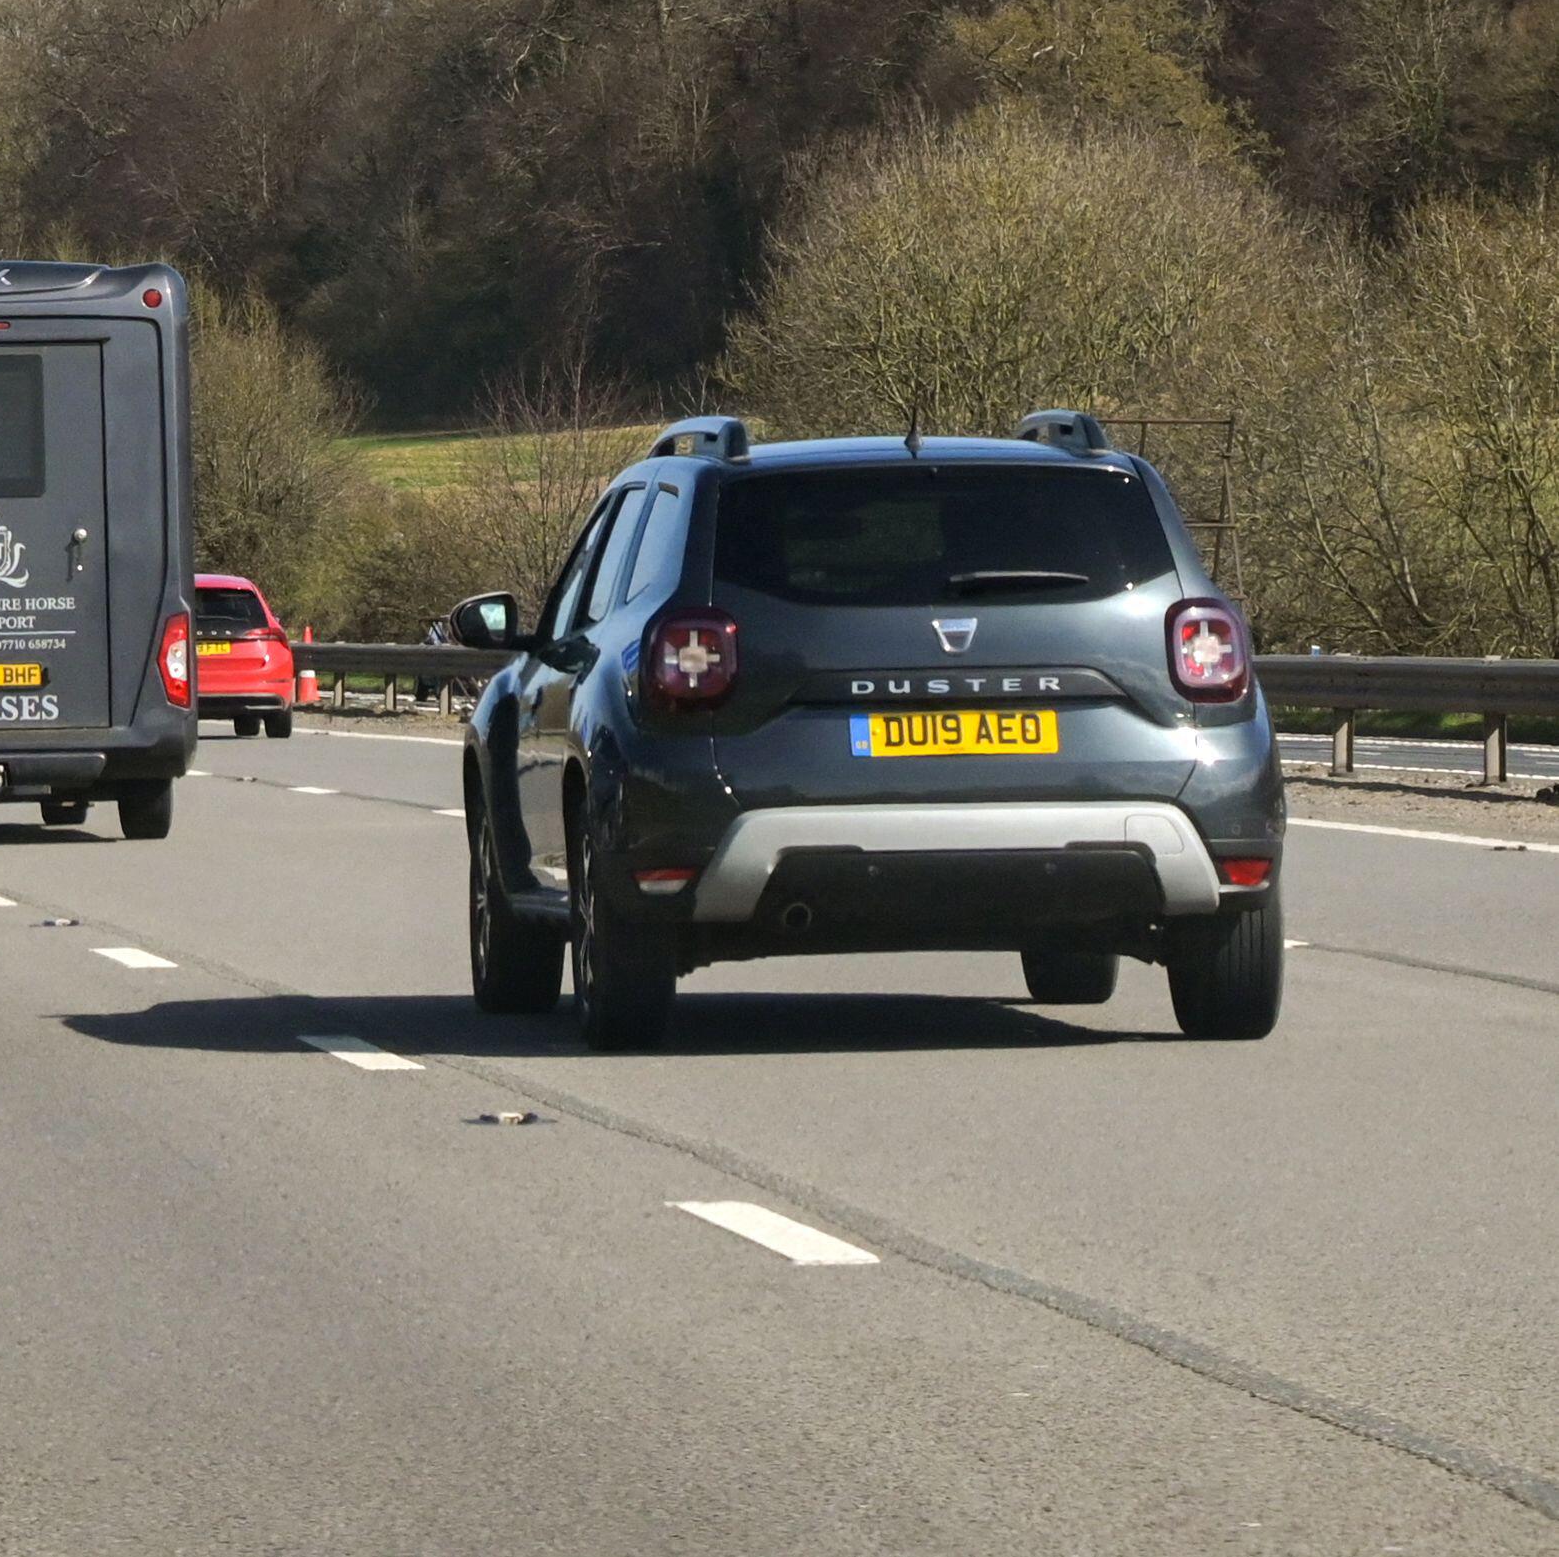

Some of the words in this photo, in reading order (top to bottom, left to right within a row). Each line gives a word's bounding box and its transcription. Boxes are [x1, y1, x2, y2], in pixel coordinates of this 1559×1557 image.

[25, 596, 76, 610] HORSE
[2, 666, 38, 683] BHF
[851, 677, 1061, 694] DUSTER
[883, 714, 962, 747] DU19
